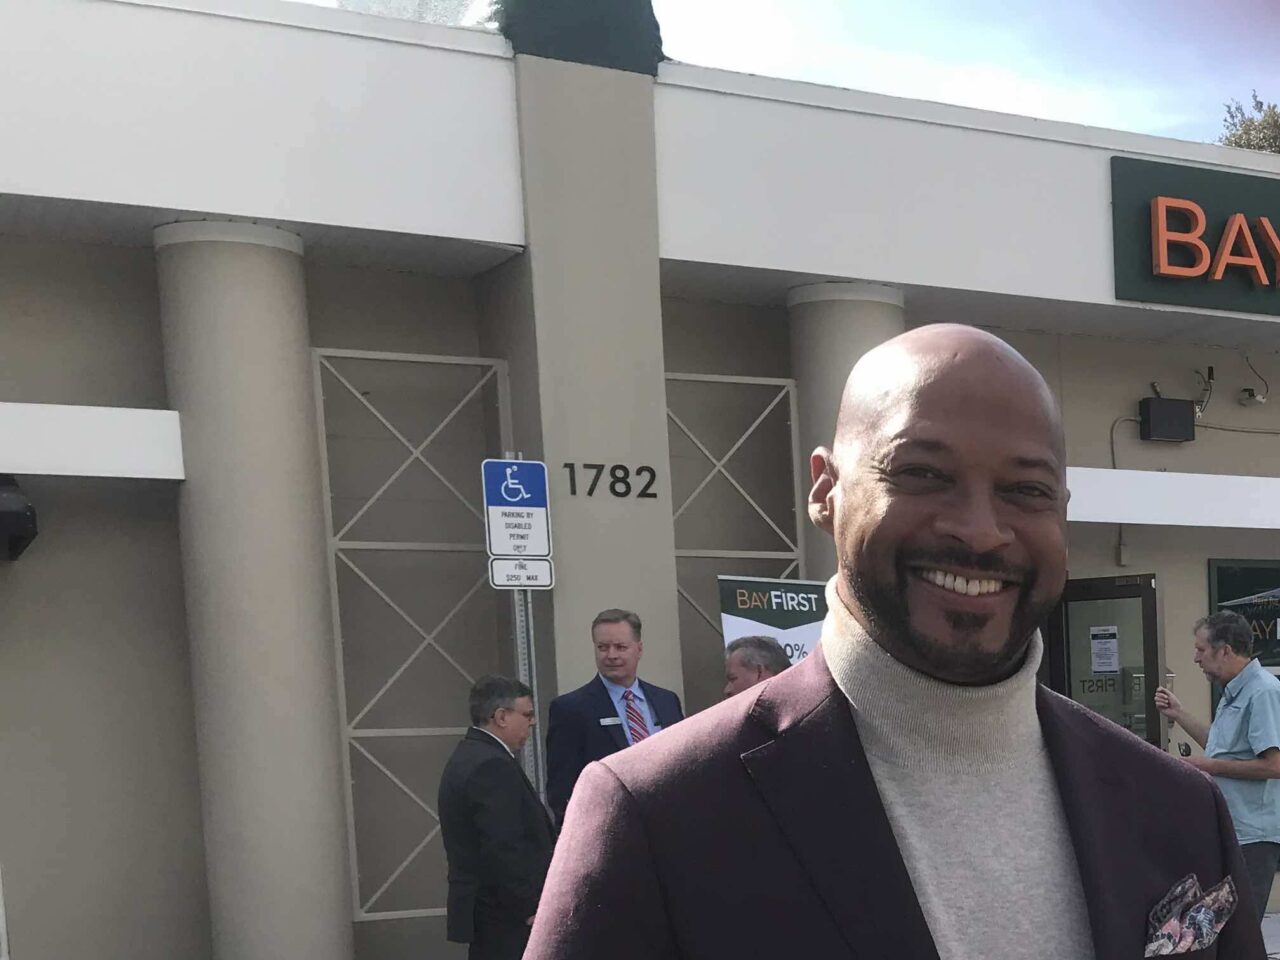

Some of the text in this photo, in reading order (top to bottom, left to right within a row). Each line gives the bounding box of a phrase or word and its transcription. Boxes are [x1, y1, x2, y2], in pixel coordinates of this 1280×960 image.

[563, 463, 658, 499] 1782
[501, 511, 525, 519] PARKING
[505, 522, 532, 530] DISABLED
[509, 533, 529, 541] PERMIT
[514, 563, 528, 571] FINE
[506, 574, 521, 582] $250
[736, 589, 818, 612] BAYFIRST
